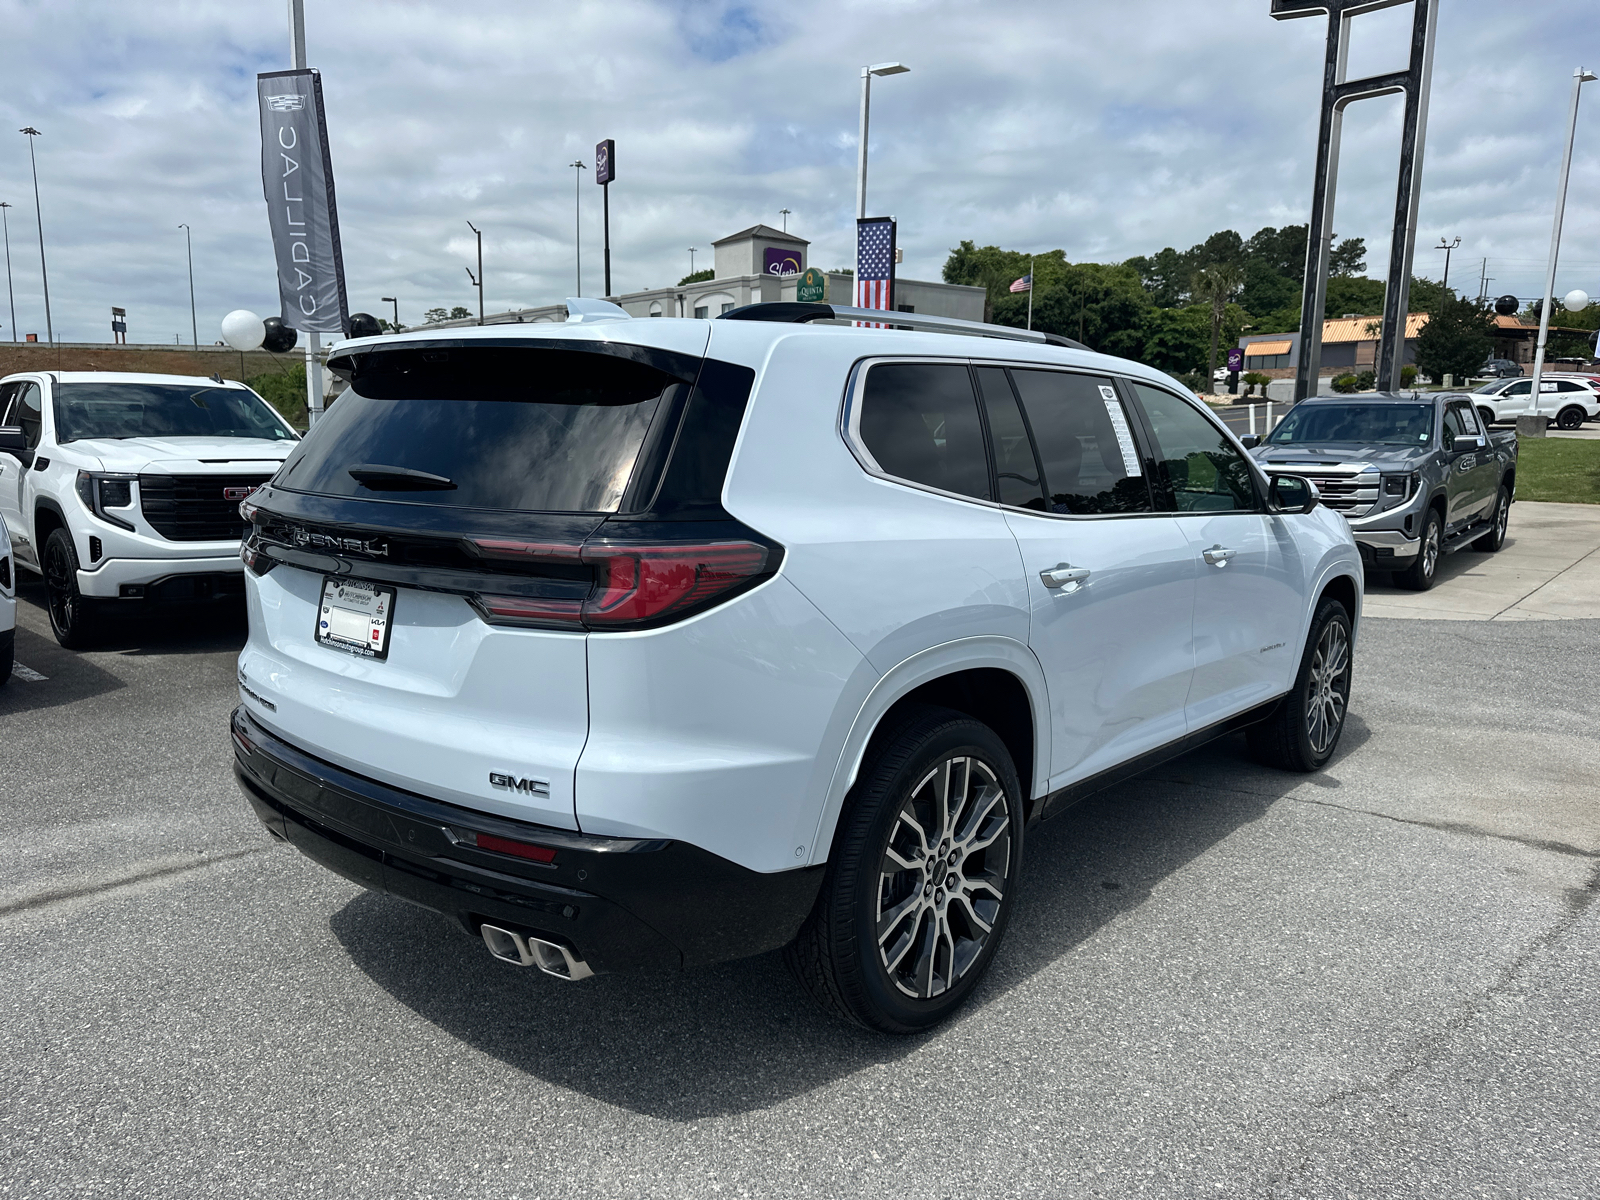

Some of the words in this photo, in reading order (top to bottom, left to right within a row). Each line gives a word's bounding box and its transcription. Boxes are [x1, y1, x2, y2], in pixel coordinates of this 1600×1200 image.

[801, 286, 823, 298] QUINTA
[294, 527, 389, 556] DENALI
[489, 772, 550, 796] GMC
